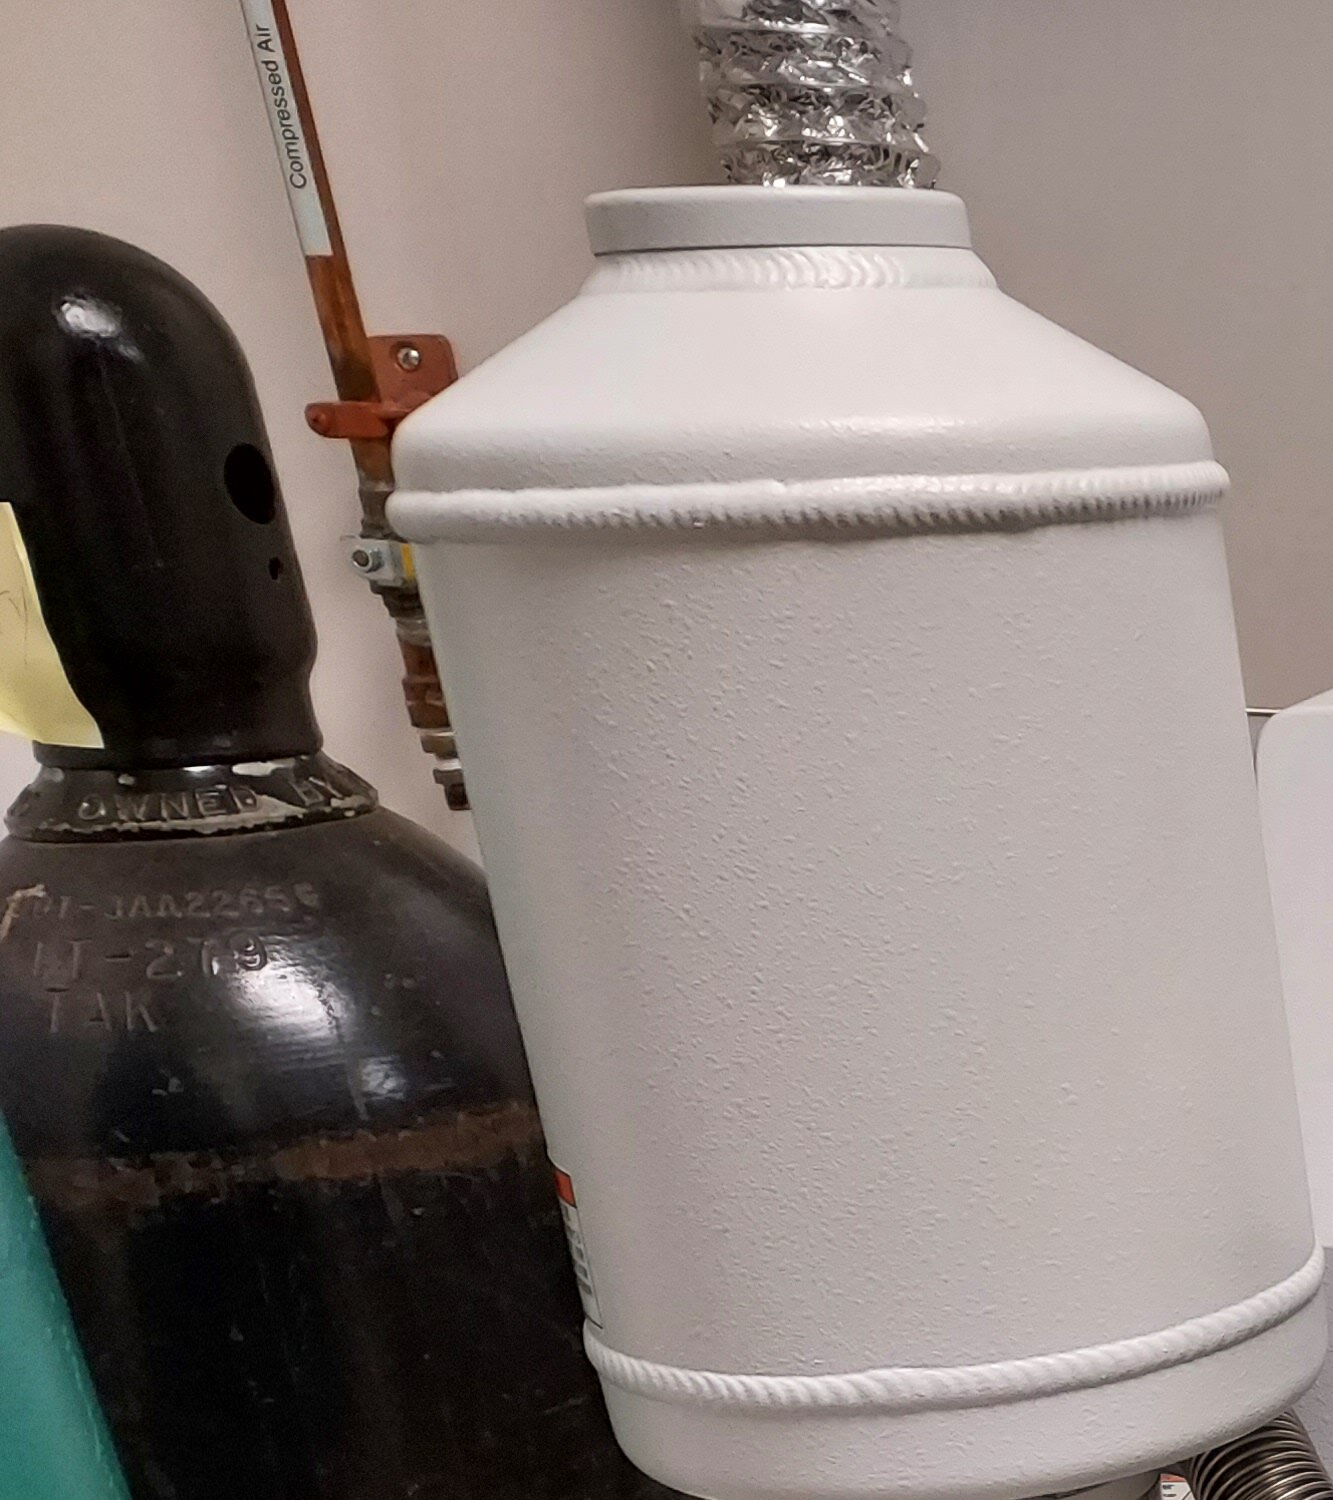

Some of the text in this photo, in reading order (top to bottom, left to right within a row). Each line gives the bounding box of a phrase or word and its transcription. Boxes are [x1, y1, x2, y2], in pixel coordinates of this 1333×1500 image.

[255, 24, 307, 189] Compressed Air
[78, 786, 262, 822] OWNED
